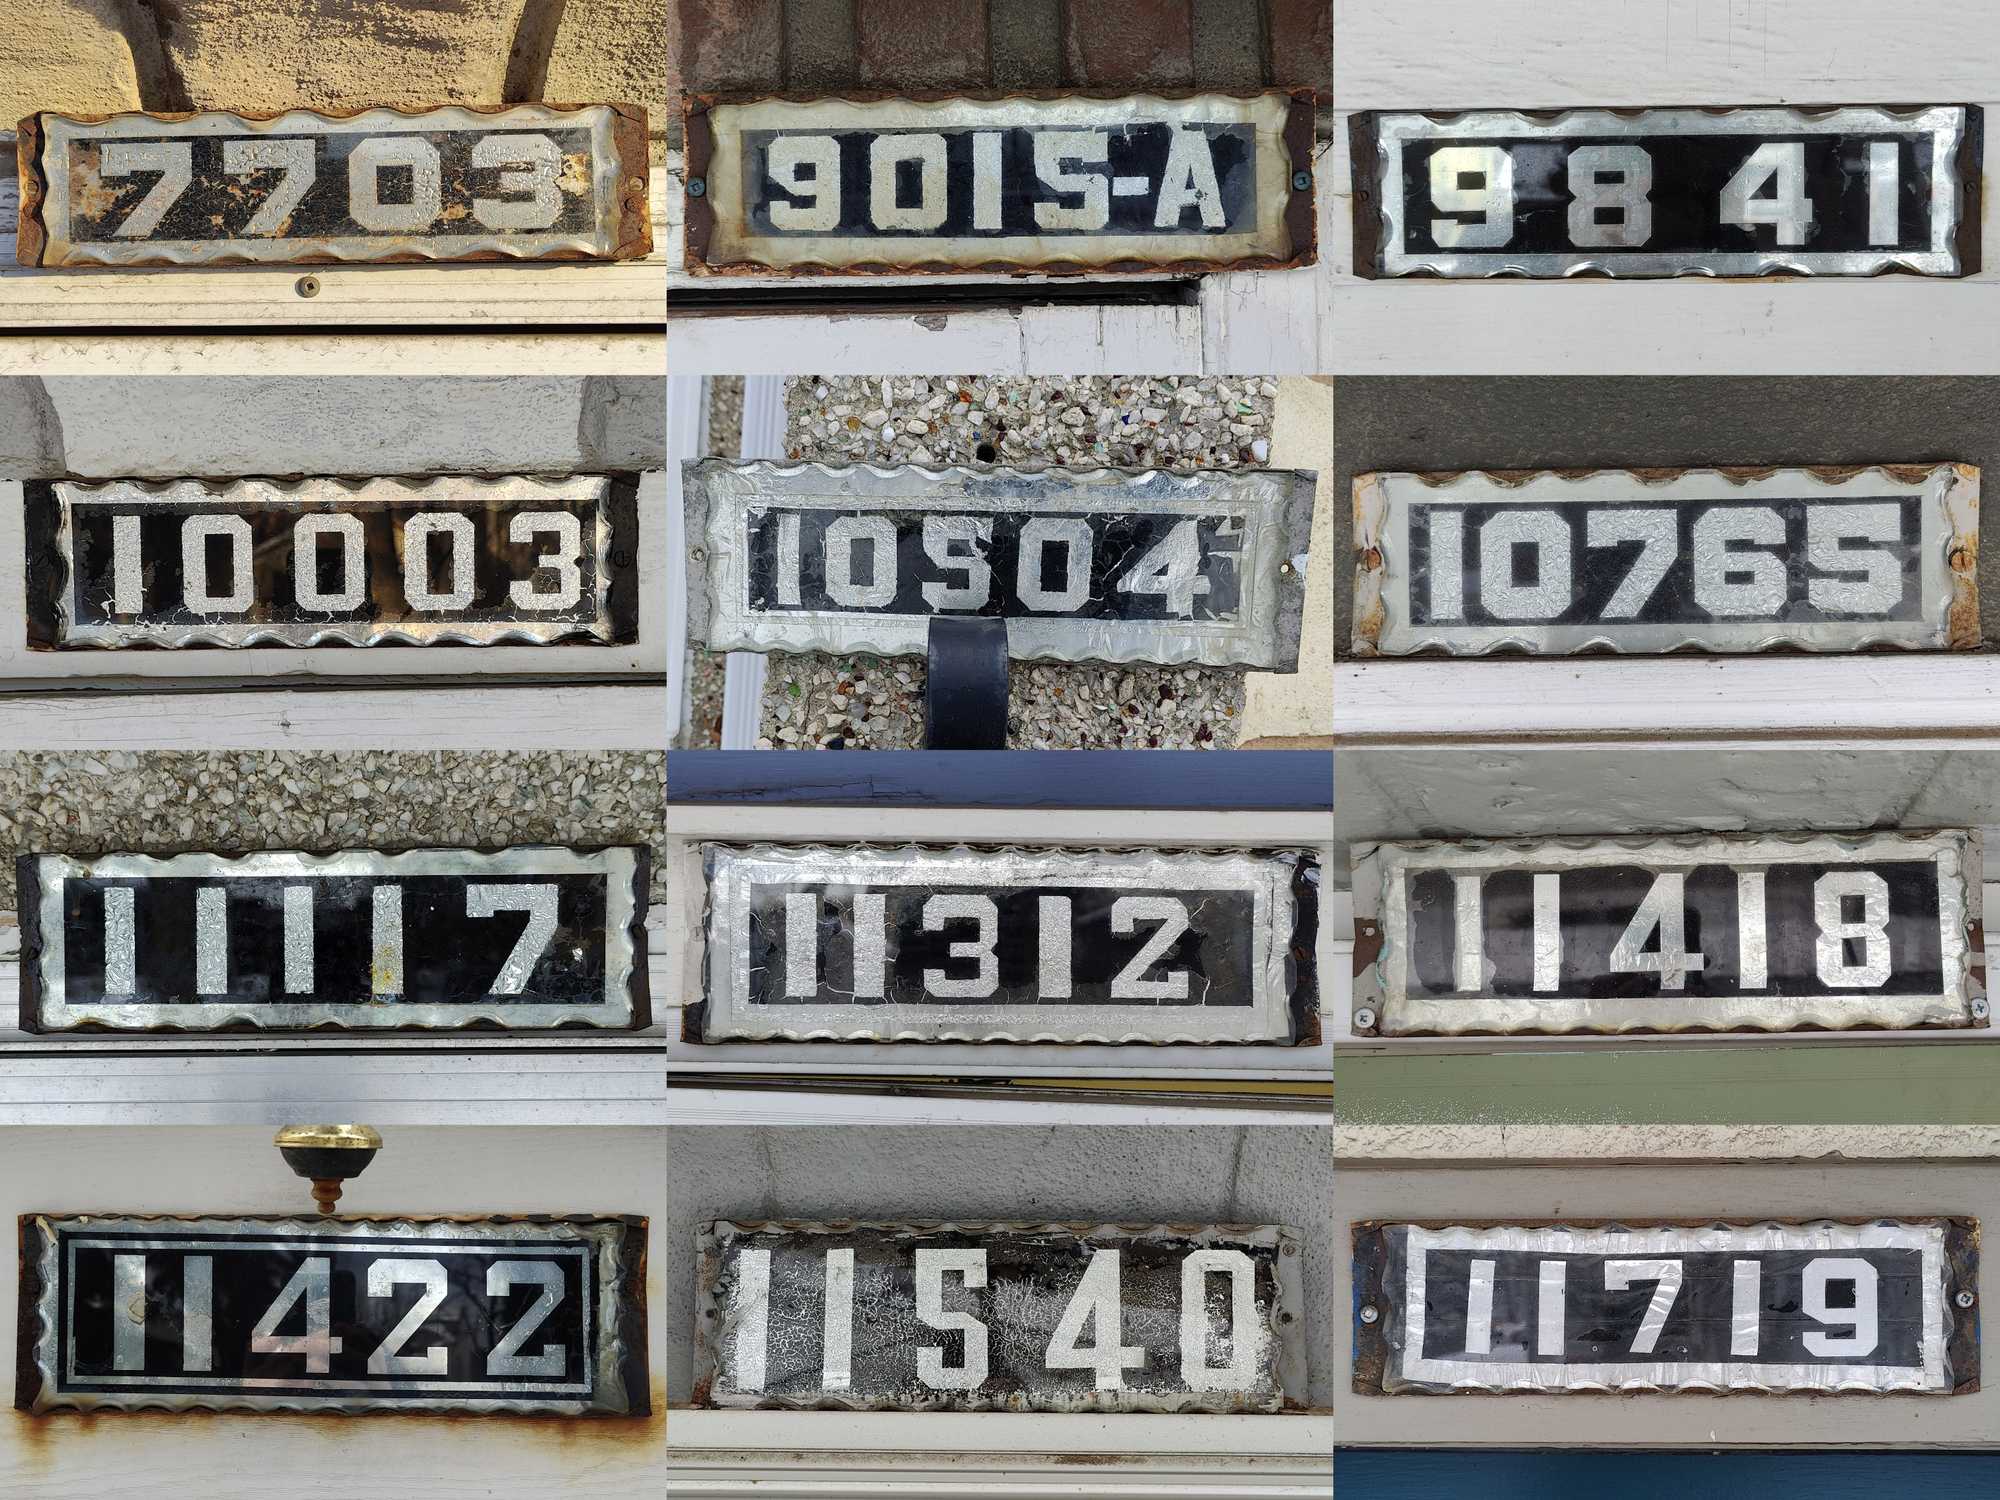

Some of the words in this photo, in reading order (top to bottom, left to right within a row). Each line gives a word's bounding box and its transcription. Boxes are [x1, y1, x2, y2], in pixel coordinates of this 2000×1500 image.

[100, 134, 562, 237] 7703
[768, 128, 1226, 233] 9015-A
[1429, 142, 1898, 249] 9841
[113, 511, 580, 614] 10003
[1430, 503, 1902, 620] 10765
[104, 883, 558, 995] 11117
[785, 892, 1189, 999] 11312
[1454, 871, 1891, 992] 11418
[113, 1255, 566, 1376] 11422
[736, 1249, 1257, 1393] 11540
[1465, 1258, 1878, 1357] 11719
